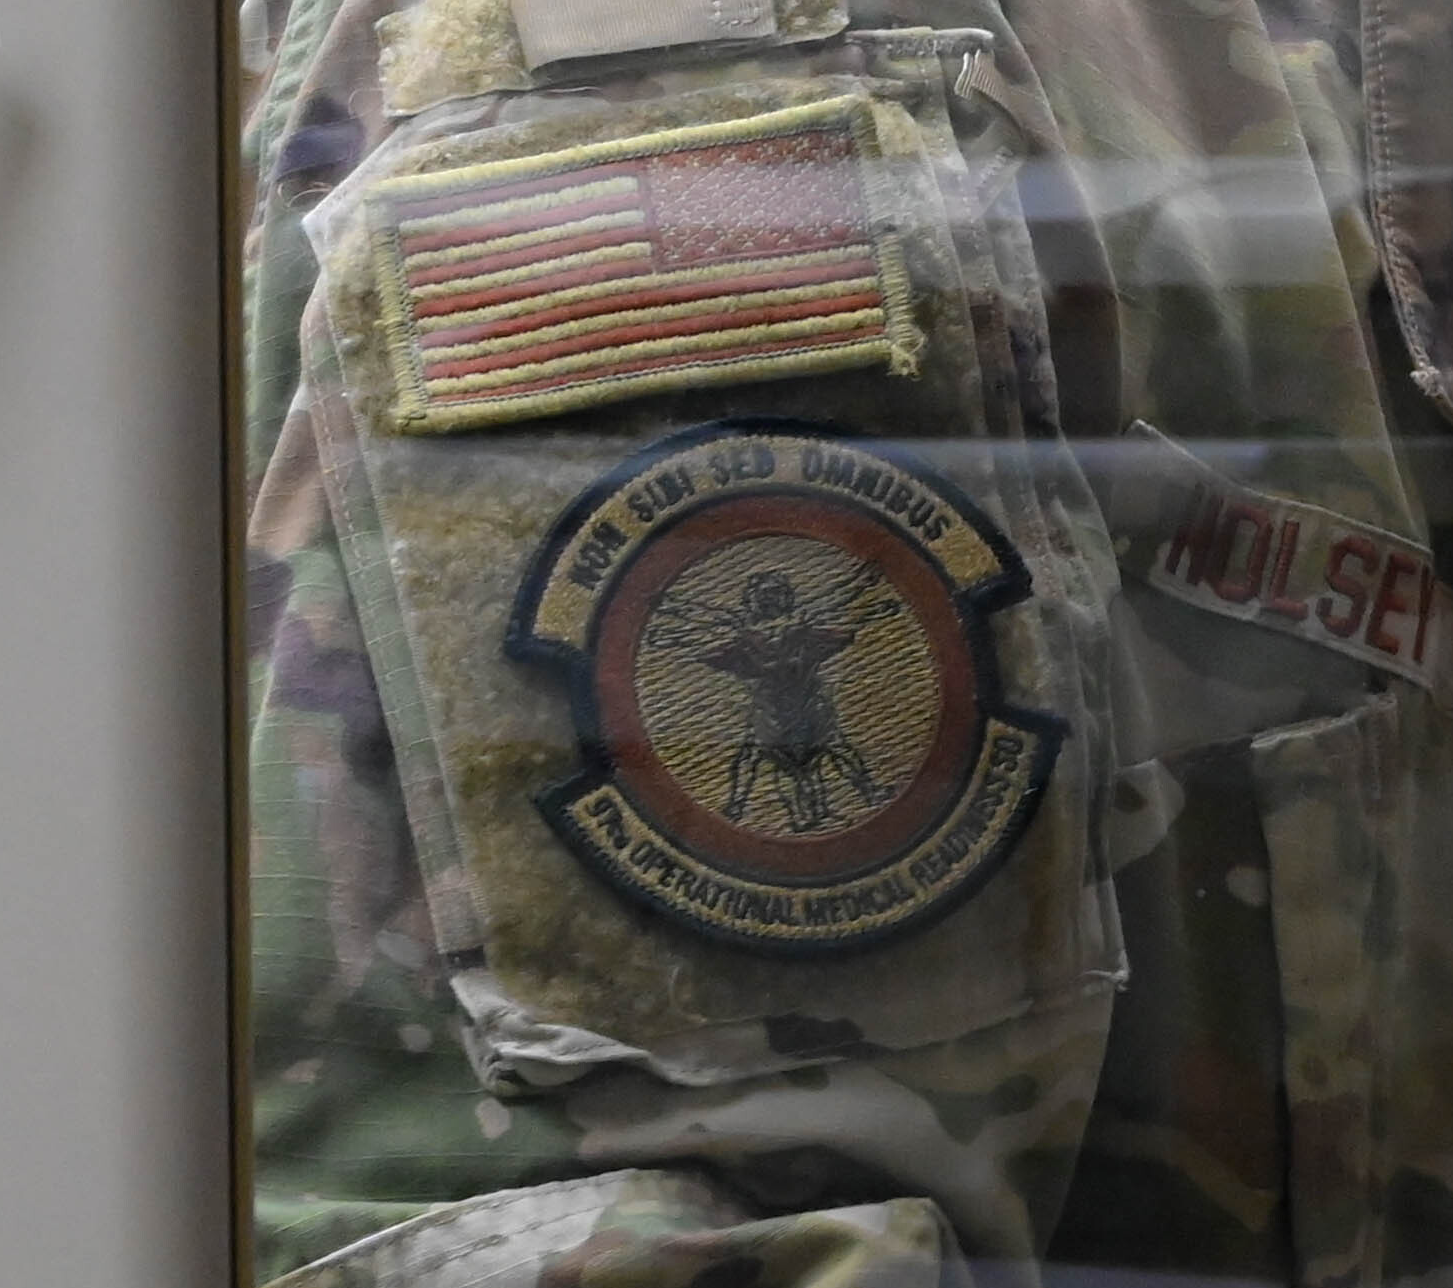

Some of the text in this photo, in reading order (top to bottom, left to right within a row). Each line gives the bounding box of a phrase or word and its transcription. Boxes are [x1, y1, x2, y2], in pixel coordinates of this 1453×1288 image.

[567, 442, 951, 591] NON SIBI SED OMNIBUS
[630, 842, 802, 926] OPERATIONAL
